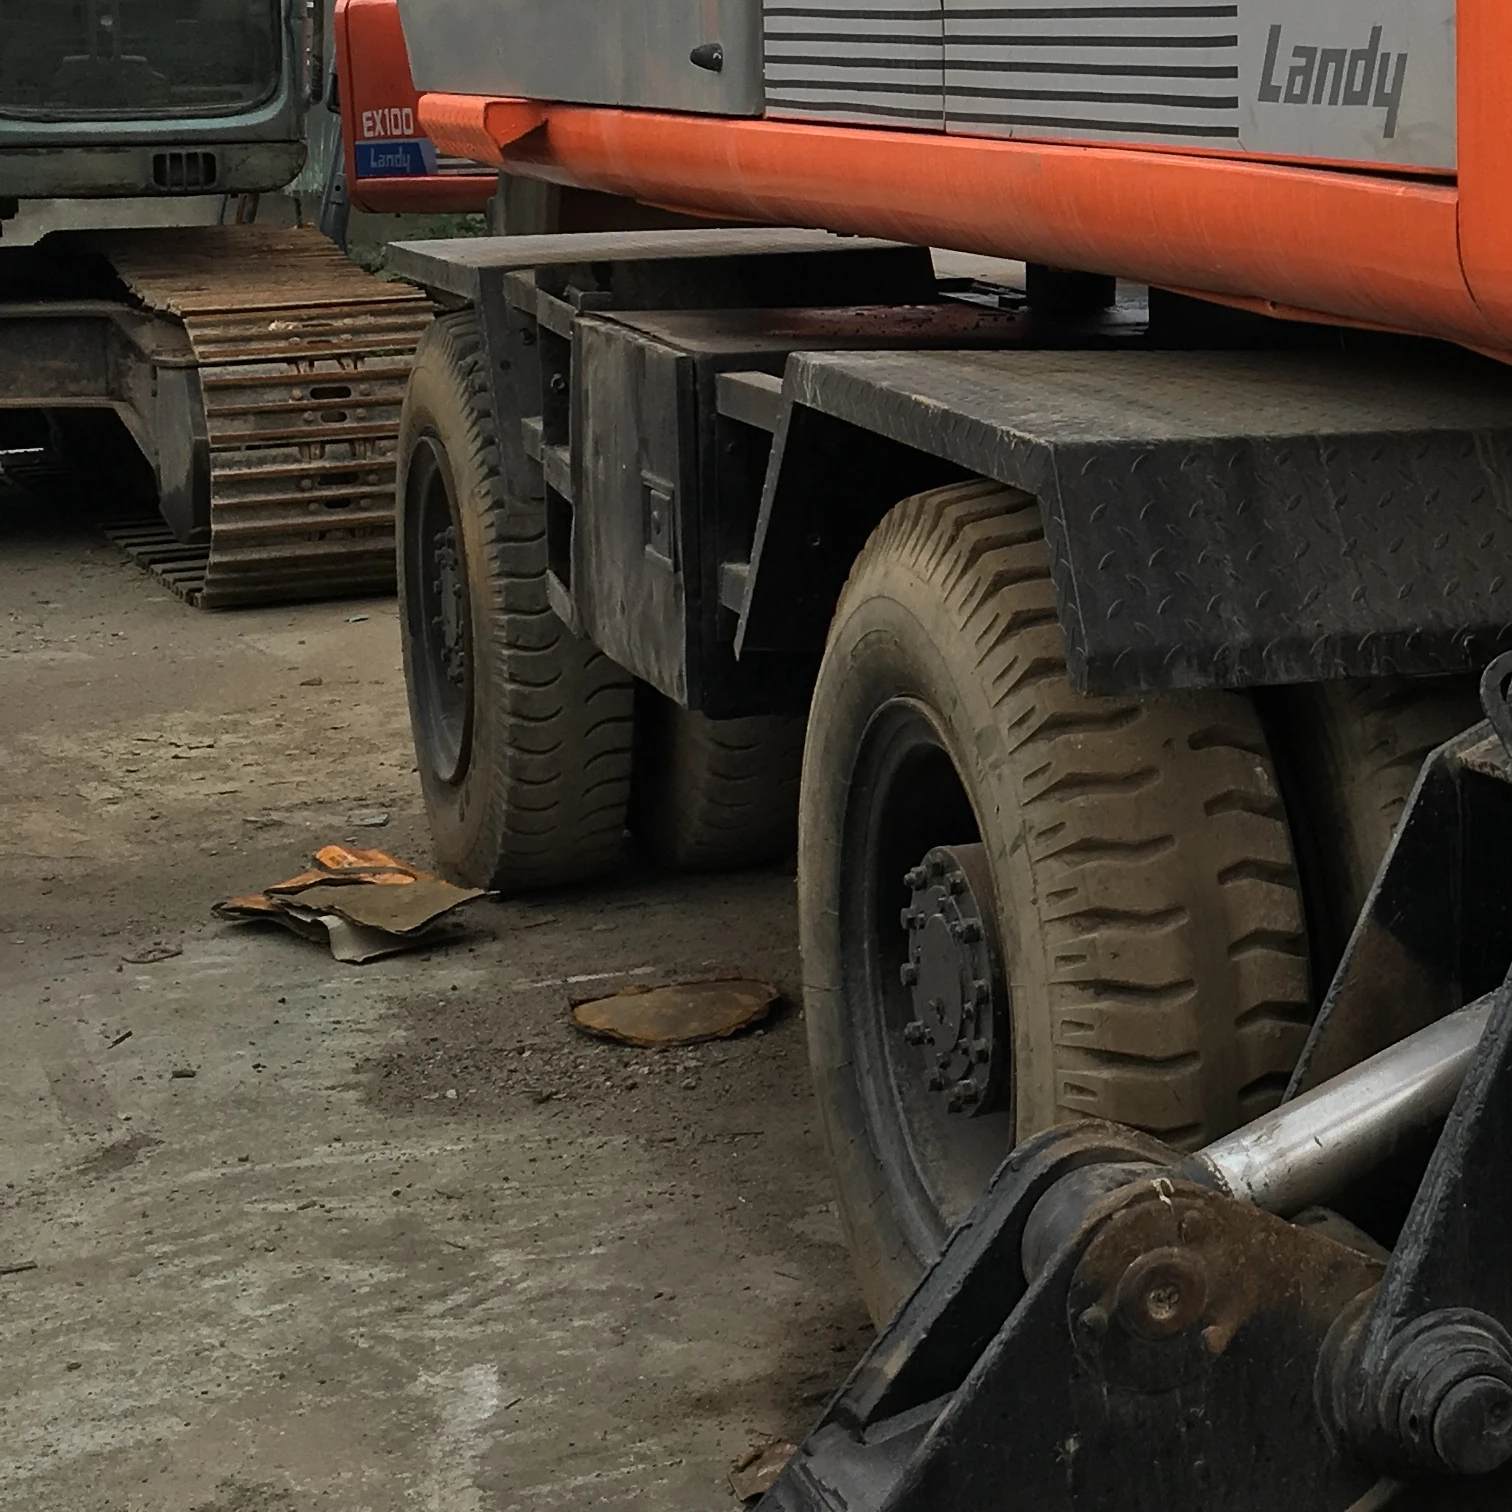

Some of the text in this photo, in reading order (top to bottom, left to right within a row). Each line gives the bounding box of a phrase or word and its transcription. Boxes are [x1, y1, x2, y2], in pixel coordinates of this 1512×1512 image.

[1257, 24, 1408, 139] Landy
[362, 107, 414, 137] EX100
[370, 147, 411, 173] Landy
